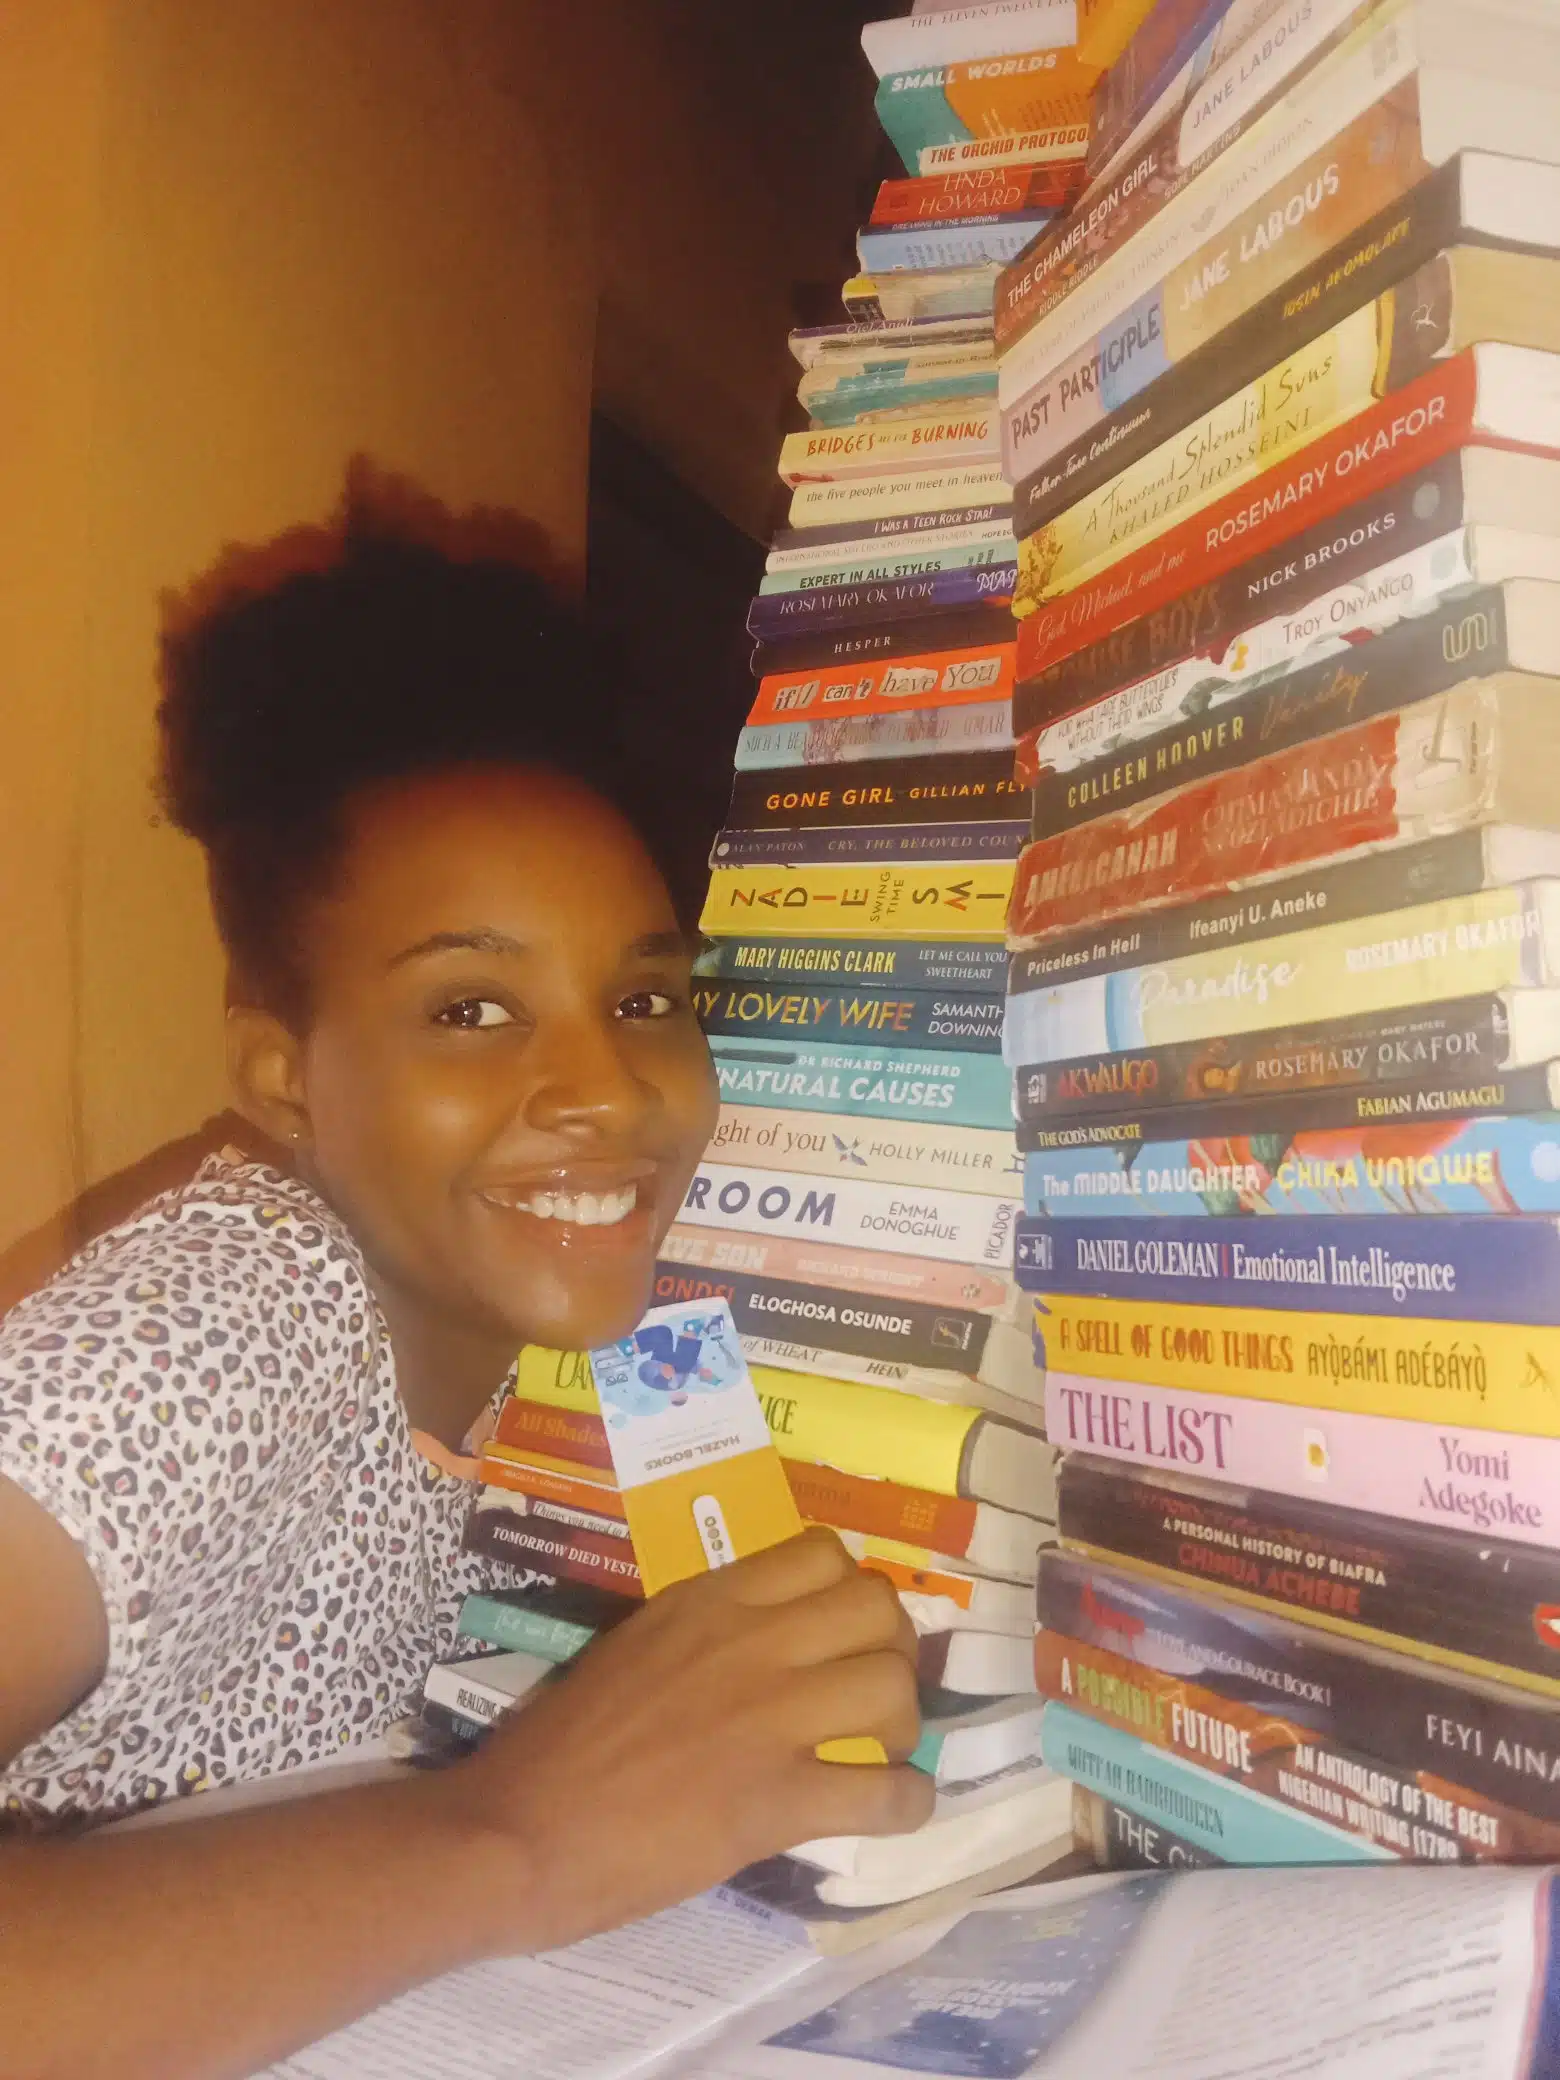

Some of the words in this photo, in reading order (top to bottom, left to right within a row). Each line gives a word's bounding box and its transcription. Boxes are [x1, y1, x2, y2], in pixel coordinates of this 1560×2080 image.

[892, 70, 956, 92] SMALL
[968, 54, 1057, 80] WORLDS
[1192, 77, 1236, 128] JANE
[1239, 7, 1312, 82] LABOUS
[930, 148, 955, 164] THE
[962, 138, 1015, 159] ORCHID
[1018, 127, 1090, 151] PROTOCO
[918, 187, 1020, 215] HOWARD
[944, 169, 1006, 192] LINDA
[1007, 275, 1032, 308] THE
[1034, 192, 1118, 283] CHAMELEON
[1122, 154, 1158, 197] GIRL
[1012, 394, 1050, 449] PAST
[1059, 303, 1160, 412] PARTICIPLE
[1179, 252, 1230, 312] JANE
[1239, 163, 1340, 263] LABOUS
[807, 433, 876, 457] BRIDGES
[911, 420, 988, 444] BURNING
[1101, 456, 1175, 525] Thousand
[1179, 383, 1265, 480] Splendid
[1275, 356, 1332, 410] Suns
[806, 490, 823, 502] the
[827, 487, 846, 501] five
[849, 482, 886, 500] people
[889, 481, 911, 495] you
[915, 478, 943, 490] meet
[947, 474, 958, 486] in
[963, 470, 1003, 485] heaven
[1110, 483, 1190, 544] KHALED
[1200, 406, 1311, 489] HOSSEINI
[1205, 463, 1328, 552] ROSEMARY
[1334, 396, 1445, 476] OKAFOR
[881, 521, 900, 533] WAS
[913, 514, 937, 529] TEEN
[939, 512, 962, 524] ROCK
[965, 506, 993, 523] STAR!
[800, 572, 844, 588] EXPERT
[850, 571, 863, 582] IN
[866, 567, 889, 581] ALL
[894, 561, 941, 576] STYLES
[1247, 563, 1298, 599] NICK
[1304, 512, 1396, 565] BROOKS
[780, 595, 859, 614] ROSEMARY
[867, 582, 934, 602] OKAFOR
[834, 636, 891, 654] HESPER
[775, 690, 793, 710] if
[882, 672, 935, 692] have
[1067, 757, 1148, 808] COLLEEN
[1157, 716, 1244, 771] HOOVER
[767, 791, 831, 810] GONE
[842, 787, 895, 805] GIRL
[910, 783, 985, 799] GILLIAN
[864, 839, 893, 850] THE
[900, 834, 972, 850] BELOVED
[730, 885, 870, 909] ZADIE
[869, 871, 892, 923] SWING
[886, 879, 904, 915] TIME
[1027, 950, 1089, 976] Priceless
[1093, 945, 1107, 960] In
[1110, 933, 1141, 956] Hell
[1189, 904, 1244, 941] Ifeanyi
[1248, 906, 1266, 925] U.
[1270, 890, 1328, 919] Aneke
[1345, 930, 1448, 972] ROSEMARY
[1455, 908, 1543, 950] OKAFOR
[735, 946, 773, 969] MARY
[778, 947, 841, 972] HIGGINS
[844, 951, 896, 973] CLARK
[919, 950, 937, 961] LET
[940, 951, 954, 961] ME
[956, 951, 981, 962] CALL
[985, 952, 1008, 964] YOU
[925, 967, 993, 980] SWEETHEART
[724, 992, 833, 1025] LOVELY
[839, 998, 916, 1032] WIFE
[821, 1057, 882, 1073] RICHARD
[887, 1061, 961, 1077] SHEPHERD
[1057, 1058, 1159, 1099] AKWAUGO
[1255, 1047, 1369, 1081] ROSEMARY
[1377, 1030, 1481, 1065] OKAFOR
[850, 1077, 956, 1108] CAUSES
[1037, 1130, 1058, 1147] THE
[1088, 1123, 1141, 1143] ADVOCATE
[1356, 1094, 1412, 1118] FABIAN
[1415, 1084, 1505, 1112] AGUMAGU
[757, 1121, 782, 1148] of
[783, 1128, 827, 1153] you
[869, 1143, 924, 1161] HOLLY
[930, 1149, 993, 1169] MILLER
[1043, 1175, 1070, 1196] The
[1147, 1164, 1261, 1192] DAUGHTER
[1276, 1161, 1359, 1190] CHIKA
[684, 1176, 836, 1227] ROOM
[888, 1201, 939, 1221] EMMA
[859, 1215, 960, 1241] DONOGHUE
[984, 1202, 1015, 1260] PICADOR
[1076, 1238, 1134, 1273] DANIEL
[1134, 1240, 1218, 1278] GOLEMAN
[1232, 1243, 1326, 1285] Emotional
[1329, 1246, 1456, 1303] Intelligence
[749, 1294, 837, 1323] ELOGHOSA
[840, 1309, 912, 1335] OSUNDE
[757, 1339, 823, 1362] WHEAT
[1076, 1318, 1124, 1356] SPELL
[1130, 1324, 1154, 1359] OF
[1161, 1325, 1214, 1365] GOOD
[1221, 1330, 1294, 1374] THINGS
[695, 1434, 740, 1455] HAZEL
[1060, 1387, 1135, 1452] THE
[1142, 1401, 1233, 1469] LIST
[644, 1450, 693, 1471] BOOKS
[1439, 1436, 1510, 1481] Yomi
[1419, 1476, 1544, 1528] Adegoke
[492, 1526, 567, 1557] TOMORROW
[568, 1548, 601, 1567] DIED
[1174, 1518, 1240, 1549] PERSONAL
[1242, 1534, 1303, 1562] HISTORY
[1305, 1552, 1326, 1568] OF
[1329, 1558, 1387, 1587] BIAFRA
[1179, 1543, 1261, 1588] CHINUA
[1265, 1568, 1361, 1615] ACHEBE
[1284, 1672, 1322, 1705] BOOK
[1061, 1656, 1073, 1695] A
[1171, 1702, 1253, 1774] FUTURE
[1425, 1714, 1482, 1756] FEYI
[1278, 1769, 1343, 1819] NIGERIAN
[1346, 1797, 1410, 1849] WRITING
[1294, 1743, 1314, 1770] AN
[1316, 1752, 1400, 1808] ANTHOLOGY
[1401, 1784, 1421, 1816] OF
[1424, 1791, 1455, 1831] THE
[1457, 1807, 1499, 1849] BEST
[1114, 1807, 1160, 1864] THE
